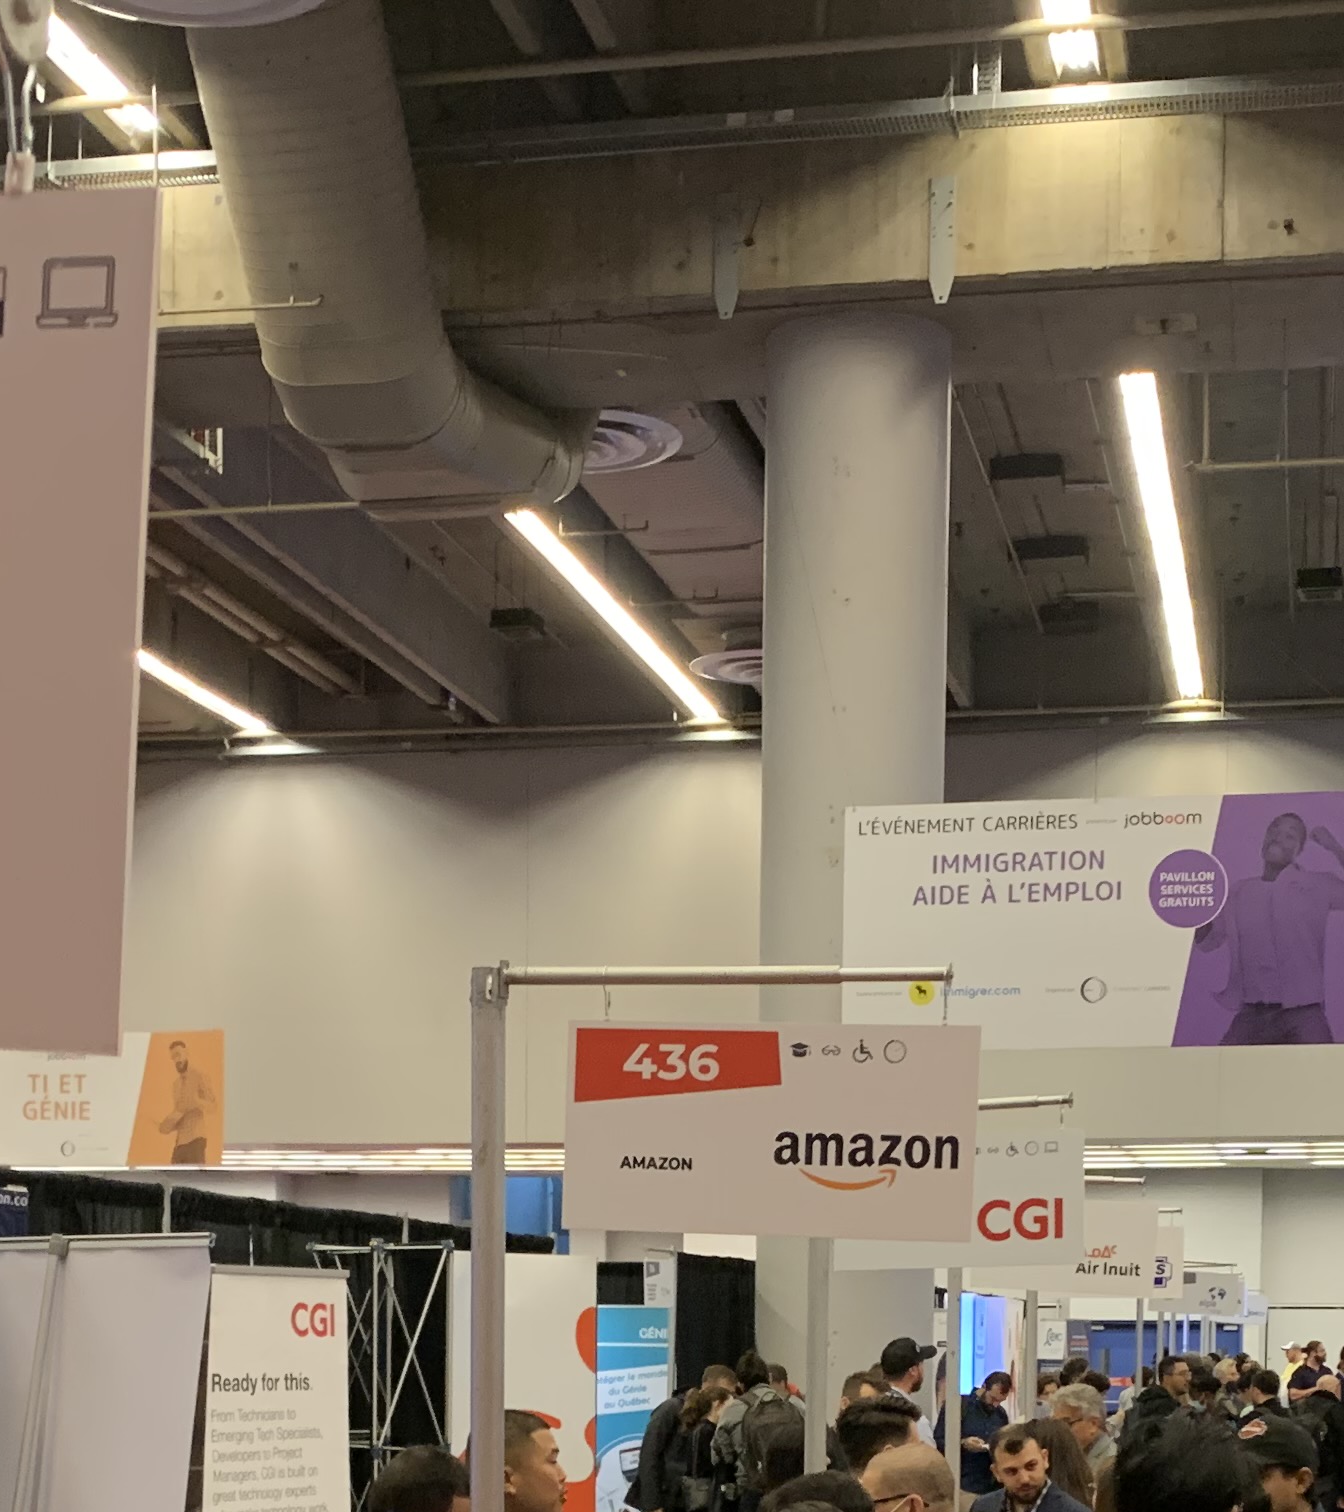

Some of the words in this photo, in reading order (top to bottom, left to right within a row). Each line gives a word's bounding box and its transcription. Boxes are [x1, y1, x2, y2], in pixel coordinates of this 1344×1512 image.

[983, 812, 1078, 832] CARRIÈRES
[1124, 811, 1202, 829] jobboom
[932, 850, 1105, 875] IMMIGRATION
[1159, 871, 1215, 882] PAVILLON
[912, 885, 970, 906] AIDE
[981, 878, 997, 904] À
[1160, 884, 1214, 895] SERVICES
[1158, 896, 1214, 907] GRATUITS
[622, 1043, 720, 1082] 436
[27, 1074, 48, 1094] TI
[59, 1074, 87, 1094] ET
[22, 1095, 91, 1120] GÉNIE
[773, 1130, 960, 1170] amazon
[620, 1155, 693, 1172] AMAZON
[977, 1198, 1064, 1242] CGI
[1075, 1260, 1098, 1275] Air
[1103, 1262, 1141, 1277] Inuit
[290, 1302, 335, 1338] CGI
[211, 1373, 258, 1396] Ready
[262, 1373, 280, 1391] for
[284, 1372, 313, 1391] this.
